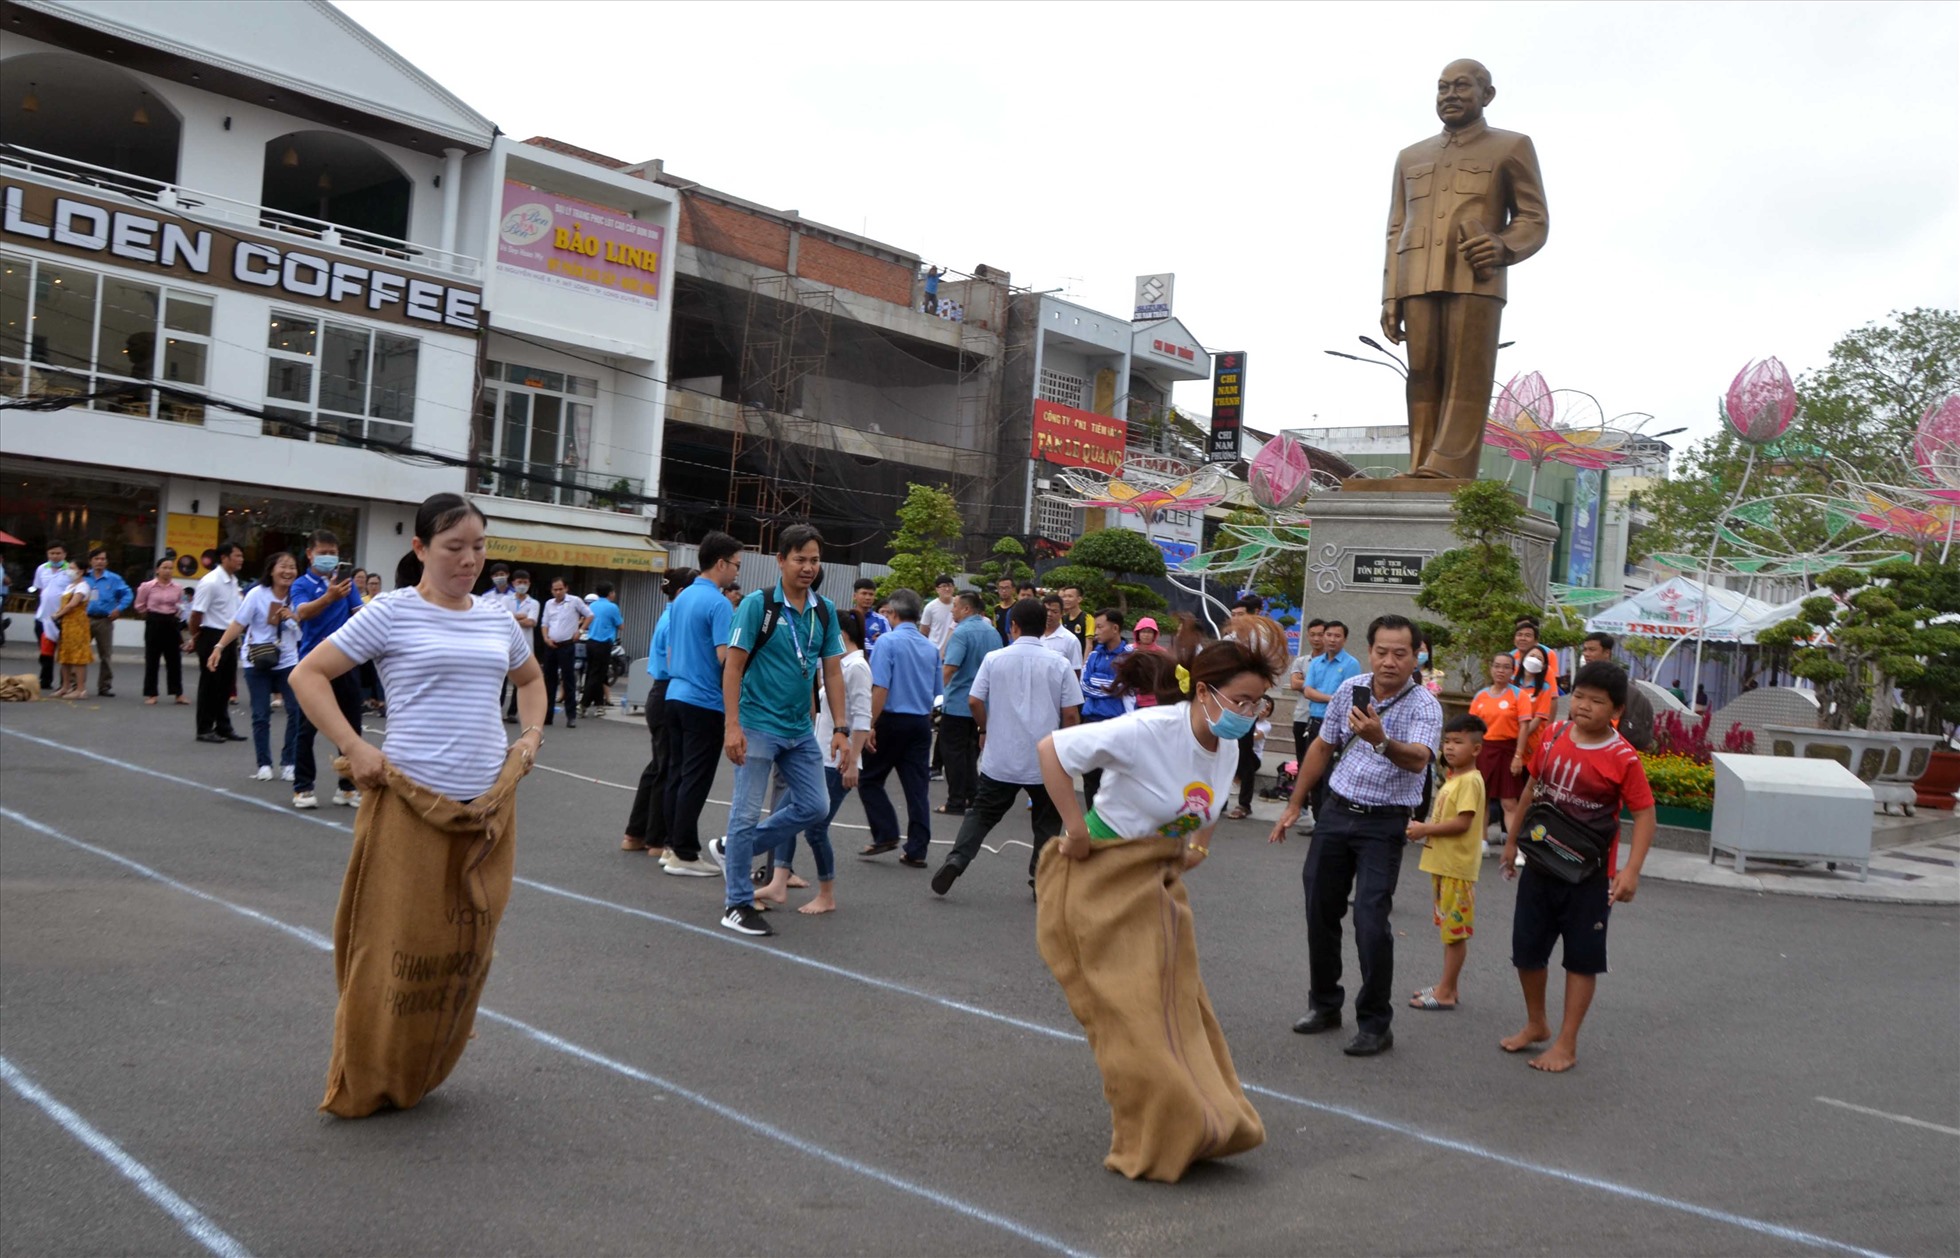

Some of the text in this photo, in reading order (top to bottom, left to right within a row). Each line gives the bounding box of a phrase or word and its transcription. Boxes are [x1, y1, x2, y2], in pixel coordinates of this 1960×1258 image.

[554, 222, 658, 273] BẢO LINH
[3, 186, 481, 330] LDEN COFFEE
[1220, 375, 1236, 383] CHI
[1218, 386, 1238, 394] NAM
[1043, 410, 1061, 424] CÔNG
[1062, 416, 1071, 426] TY
[1218, 431, 1232, 440] CHI
[1215, 441, 1234, 450] NAM
[1082, 444, 1122, 467] QUANG
[486, 538, 609, 564] Shop BẢO LINH
[1356, 565, 1418, 577] TÔN ĐỨC THẮNG
